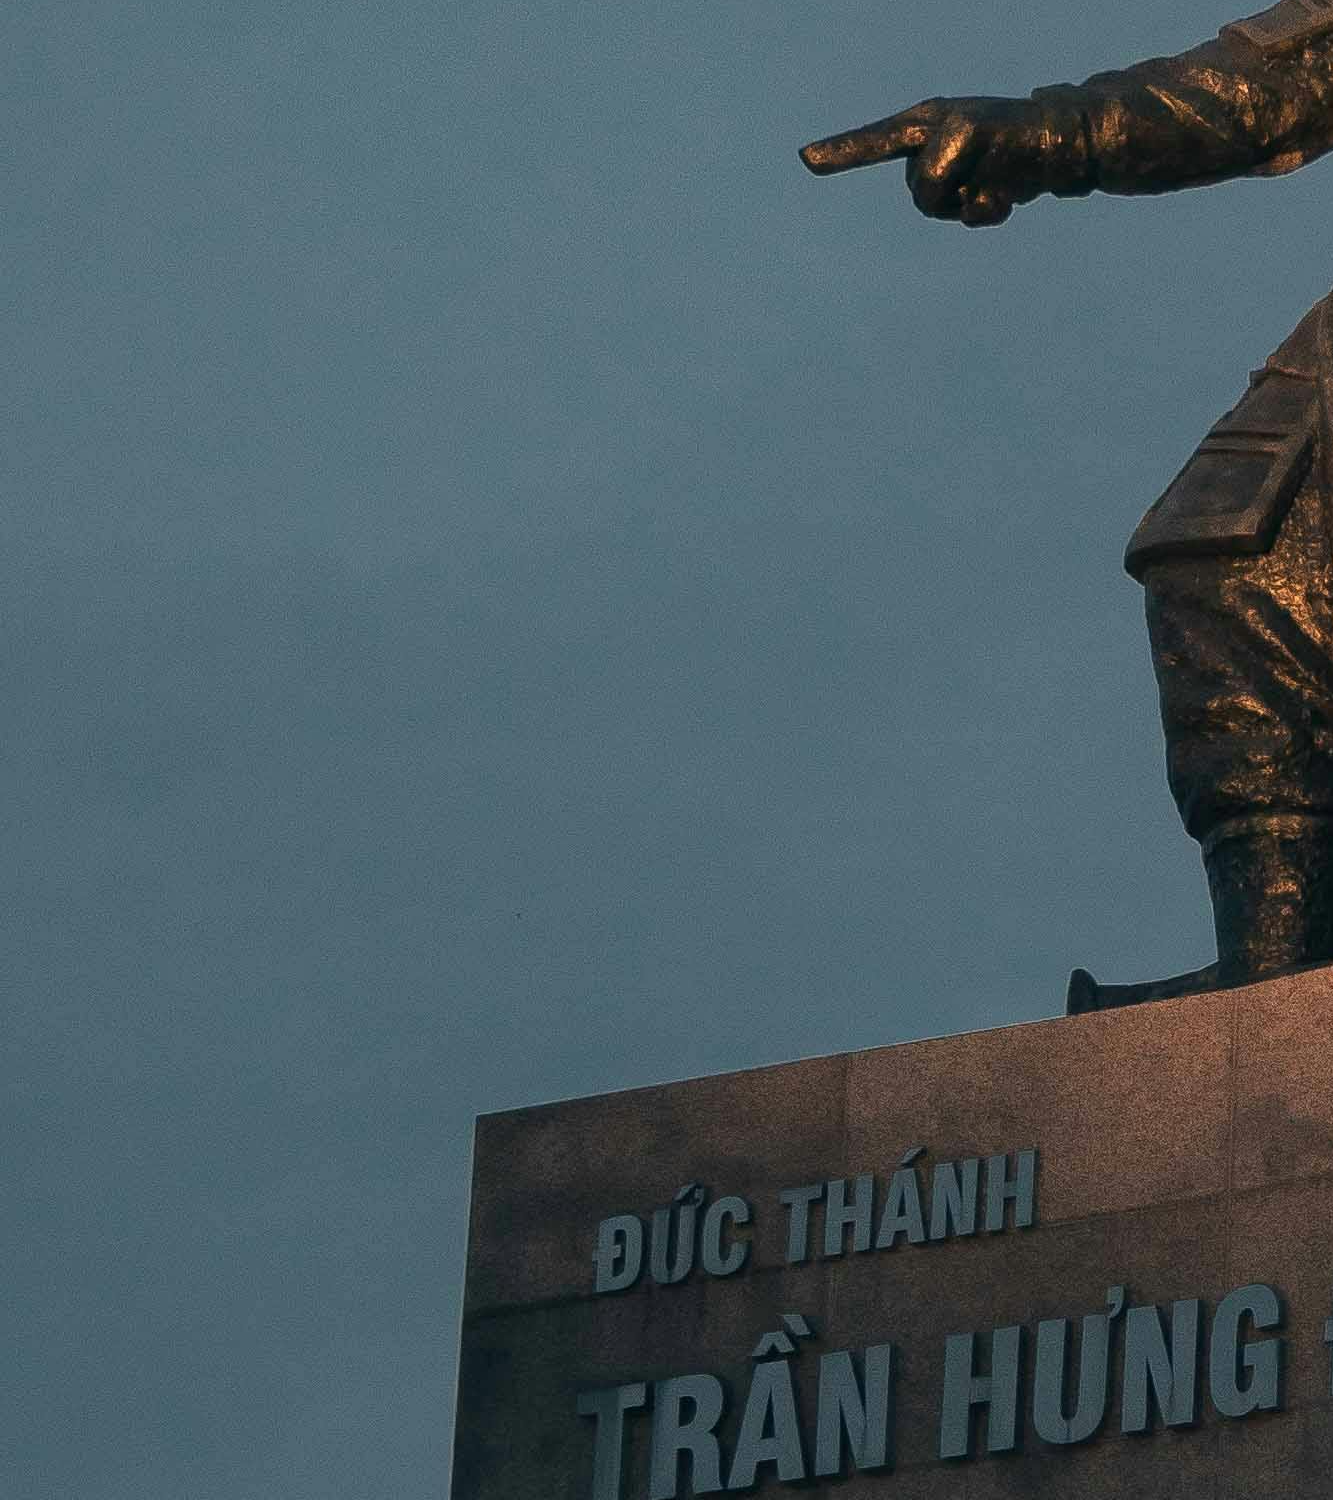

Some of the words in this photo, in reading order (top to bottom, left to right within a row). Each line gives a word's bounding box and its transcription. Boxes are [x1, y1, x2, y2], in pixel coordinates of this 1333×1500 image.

[592, 1182, 751, 1294] ĐỨC
[780, 1146, 1037, 1263] THÁNH
[940, 1285, 1284, 1460] HƯNG
